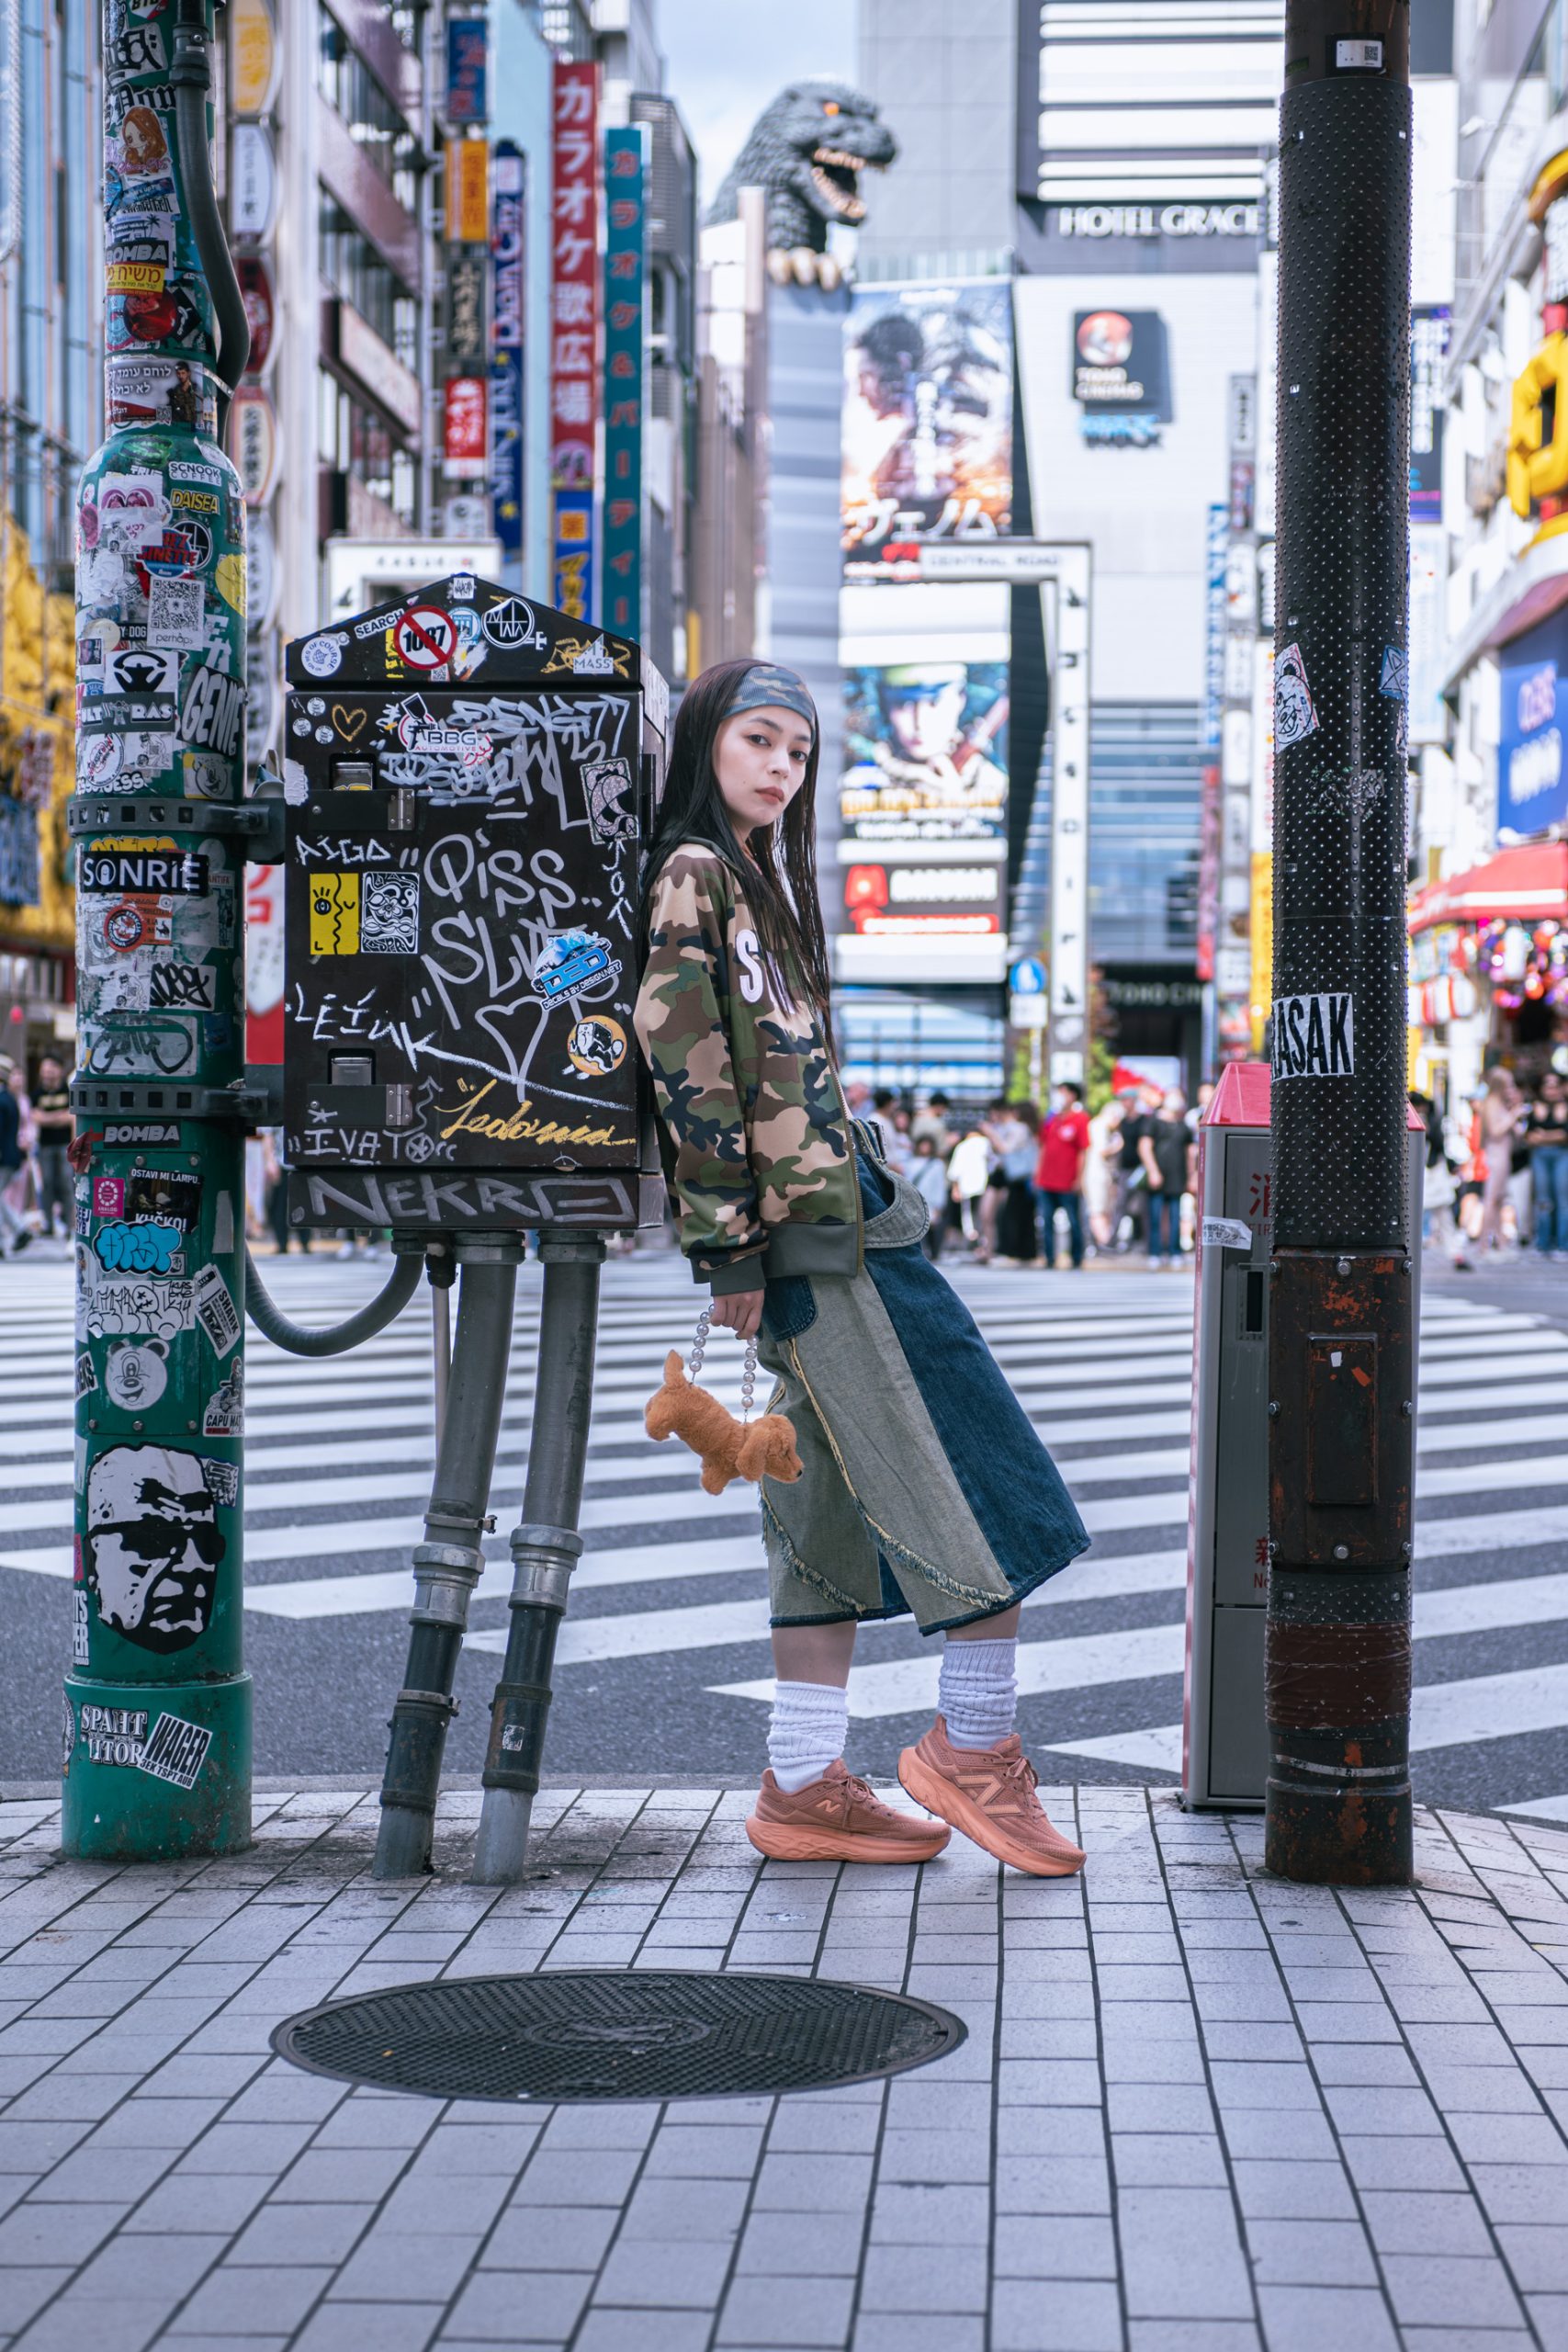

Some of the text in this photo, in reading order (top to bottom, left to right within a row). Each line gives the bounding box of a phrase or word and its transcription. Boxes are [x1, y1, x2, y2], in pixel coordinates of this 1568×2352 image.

[1059, 206, 1160, 237] HOTEL
[170, 462, 220, 478] SCNOOK
[171, 470, 221, 485] COFFEE
[172, 490, 220, 514] DAISEA
[130, 626, 147, 638] DOG
[356, 609, 404, 639] SEARCH
[574, 658, 613, 670] MASS
[427, 731, 477, 745] BBG
[104, 1124, 181, 1144] BOMBA
[131, 1168, 158, 1180] OSTAVI
[160, 1171, 169, 1181] MI
[219, 1289, 239, 1335] SHARK
[206, 1414, 228, 1427] CAPU
[145, 1714, 209, 1779] WAGER
